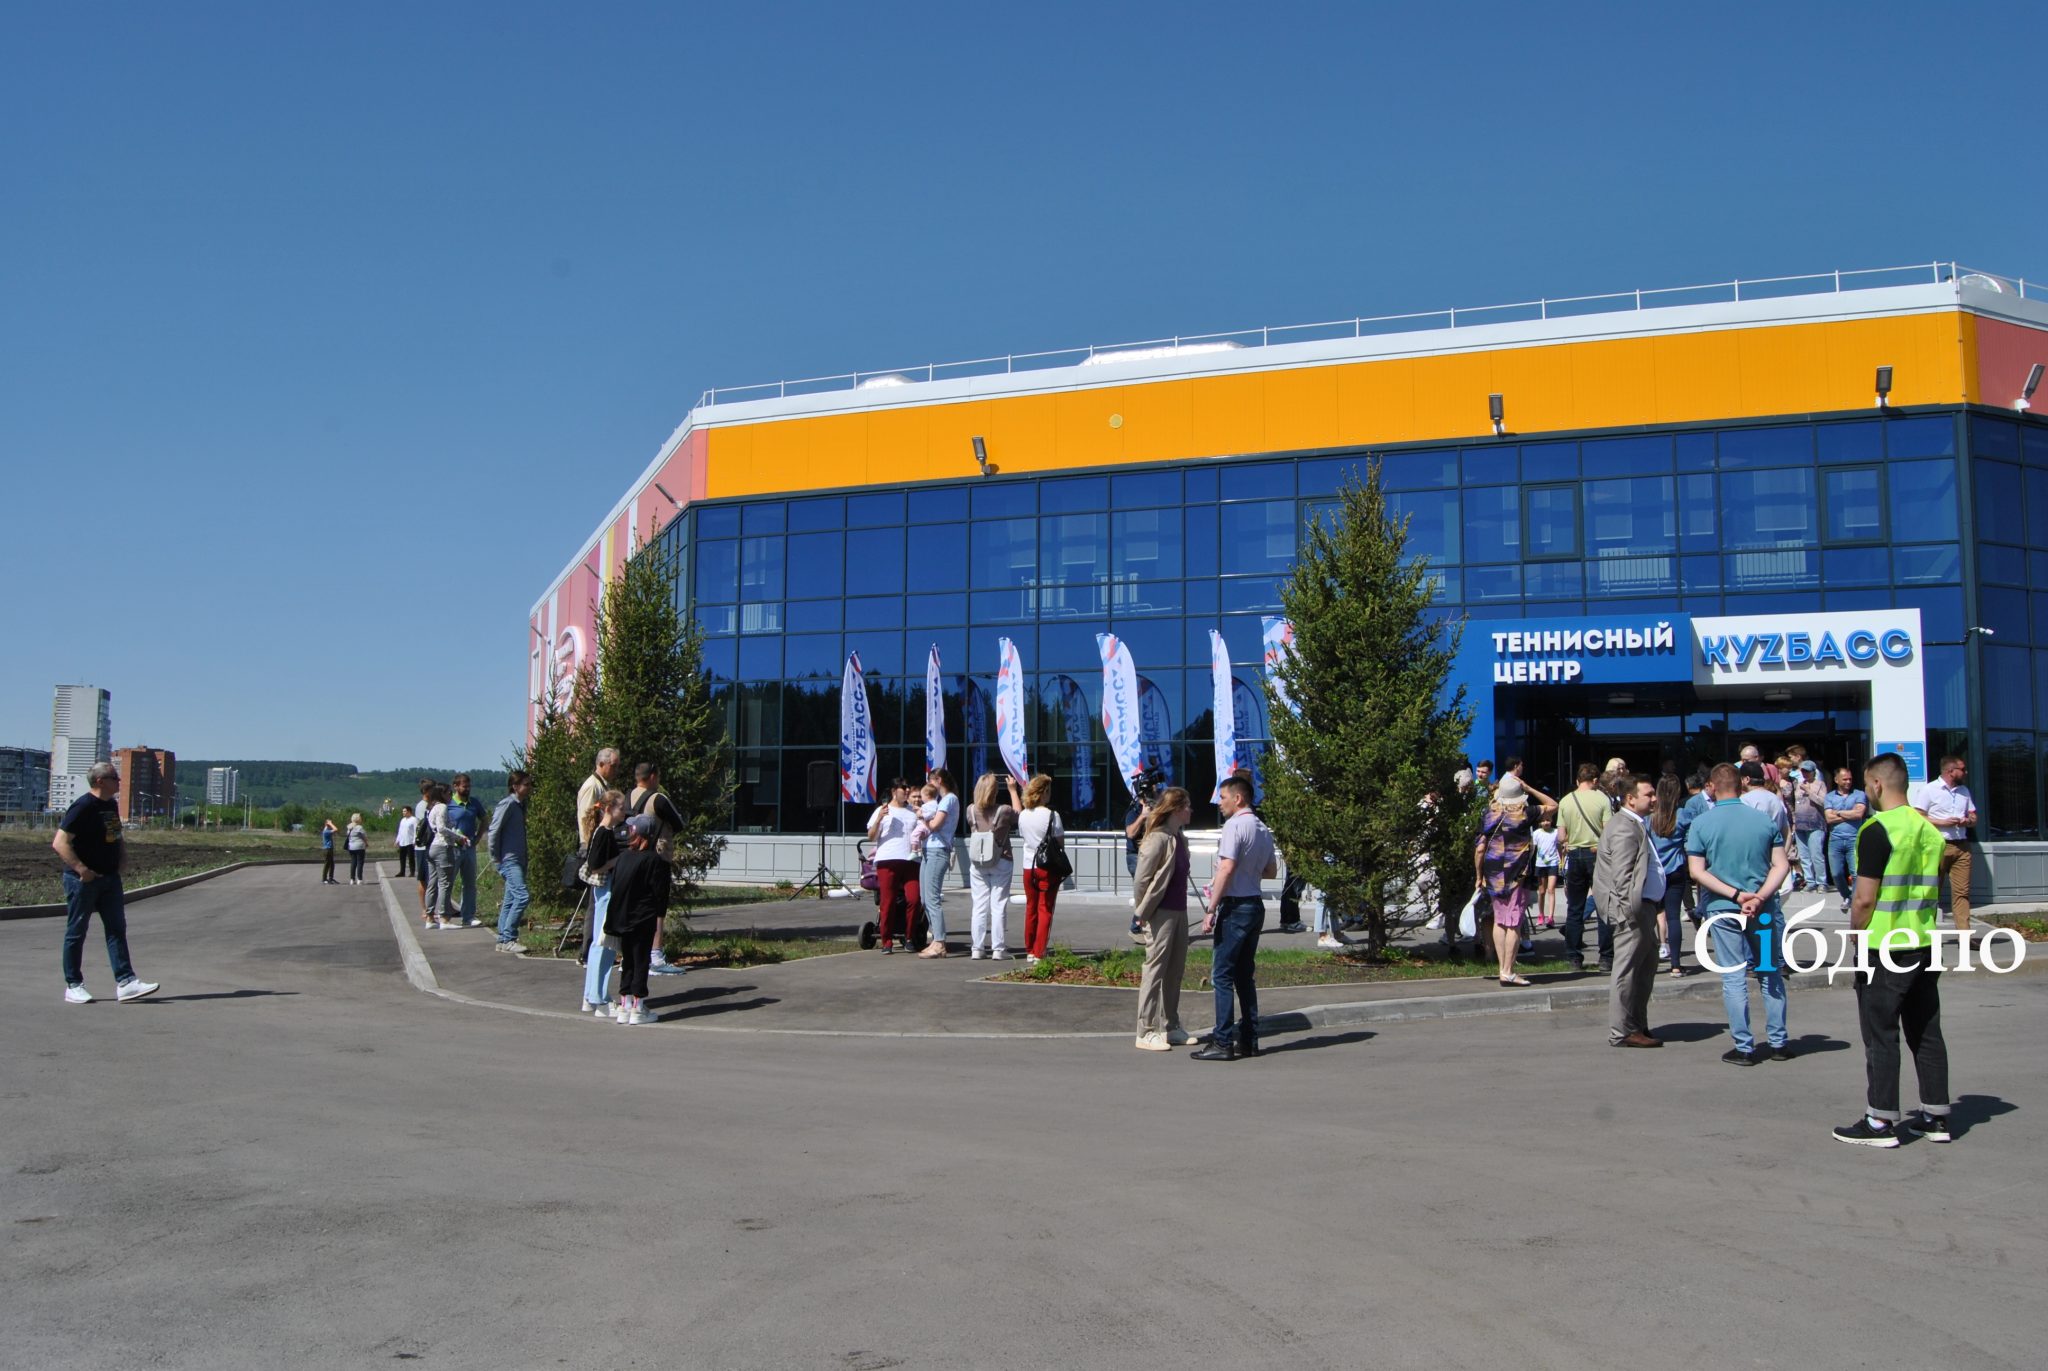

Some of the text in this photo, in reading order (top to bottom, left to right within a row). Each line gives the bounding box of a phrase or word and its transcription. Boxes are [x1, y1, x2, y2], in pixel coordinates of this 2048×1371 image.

[1492, 621, 1674, 653] ТЕННИСНЫЙ
[1703, 628, 1913, 665] КУZБАСС
[1493, 660, 1581, 683] ЦЕНТР
